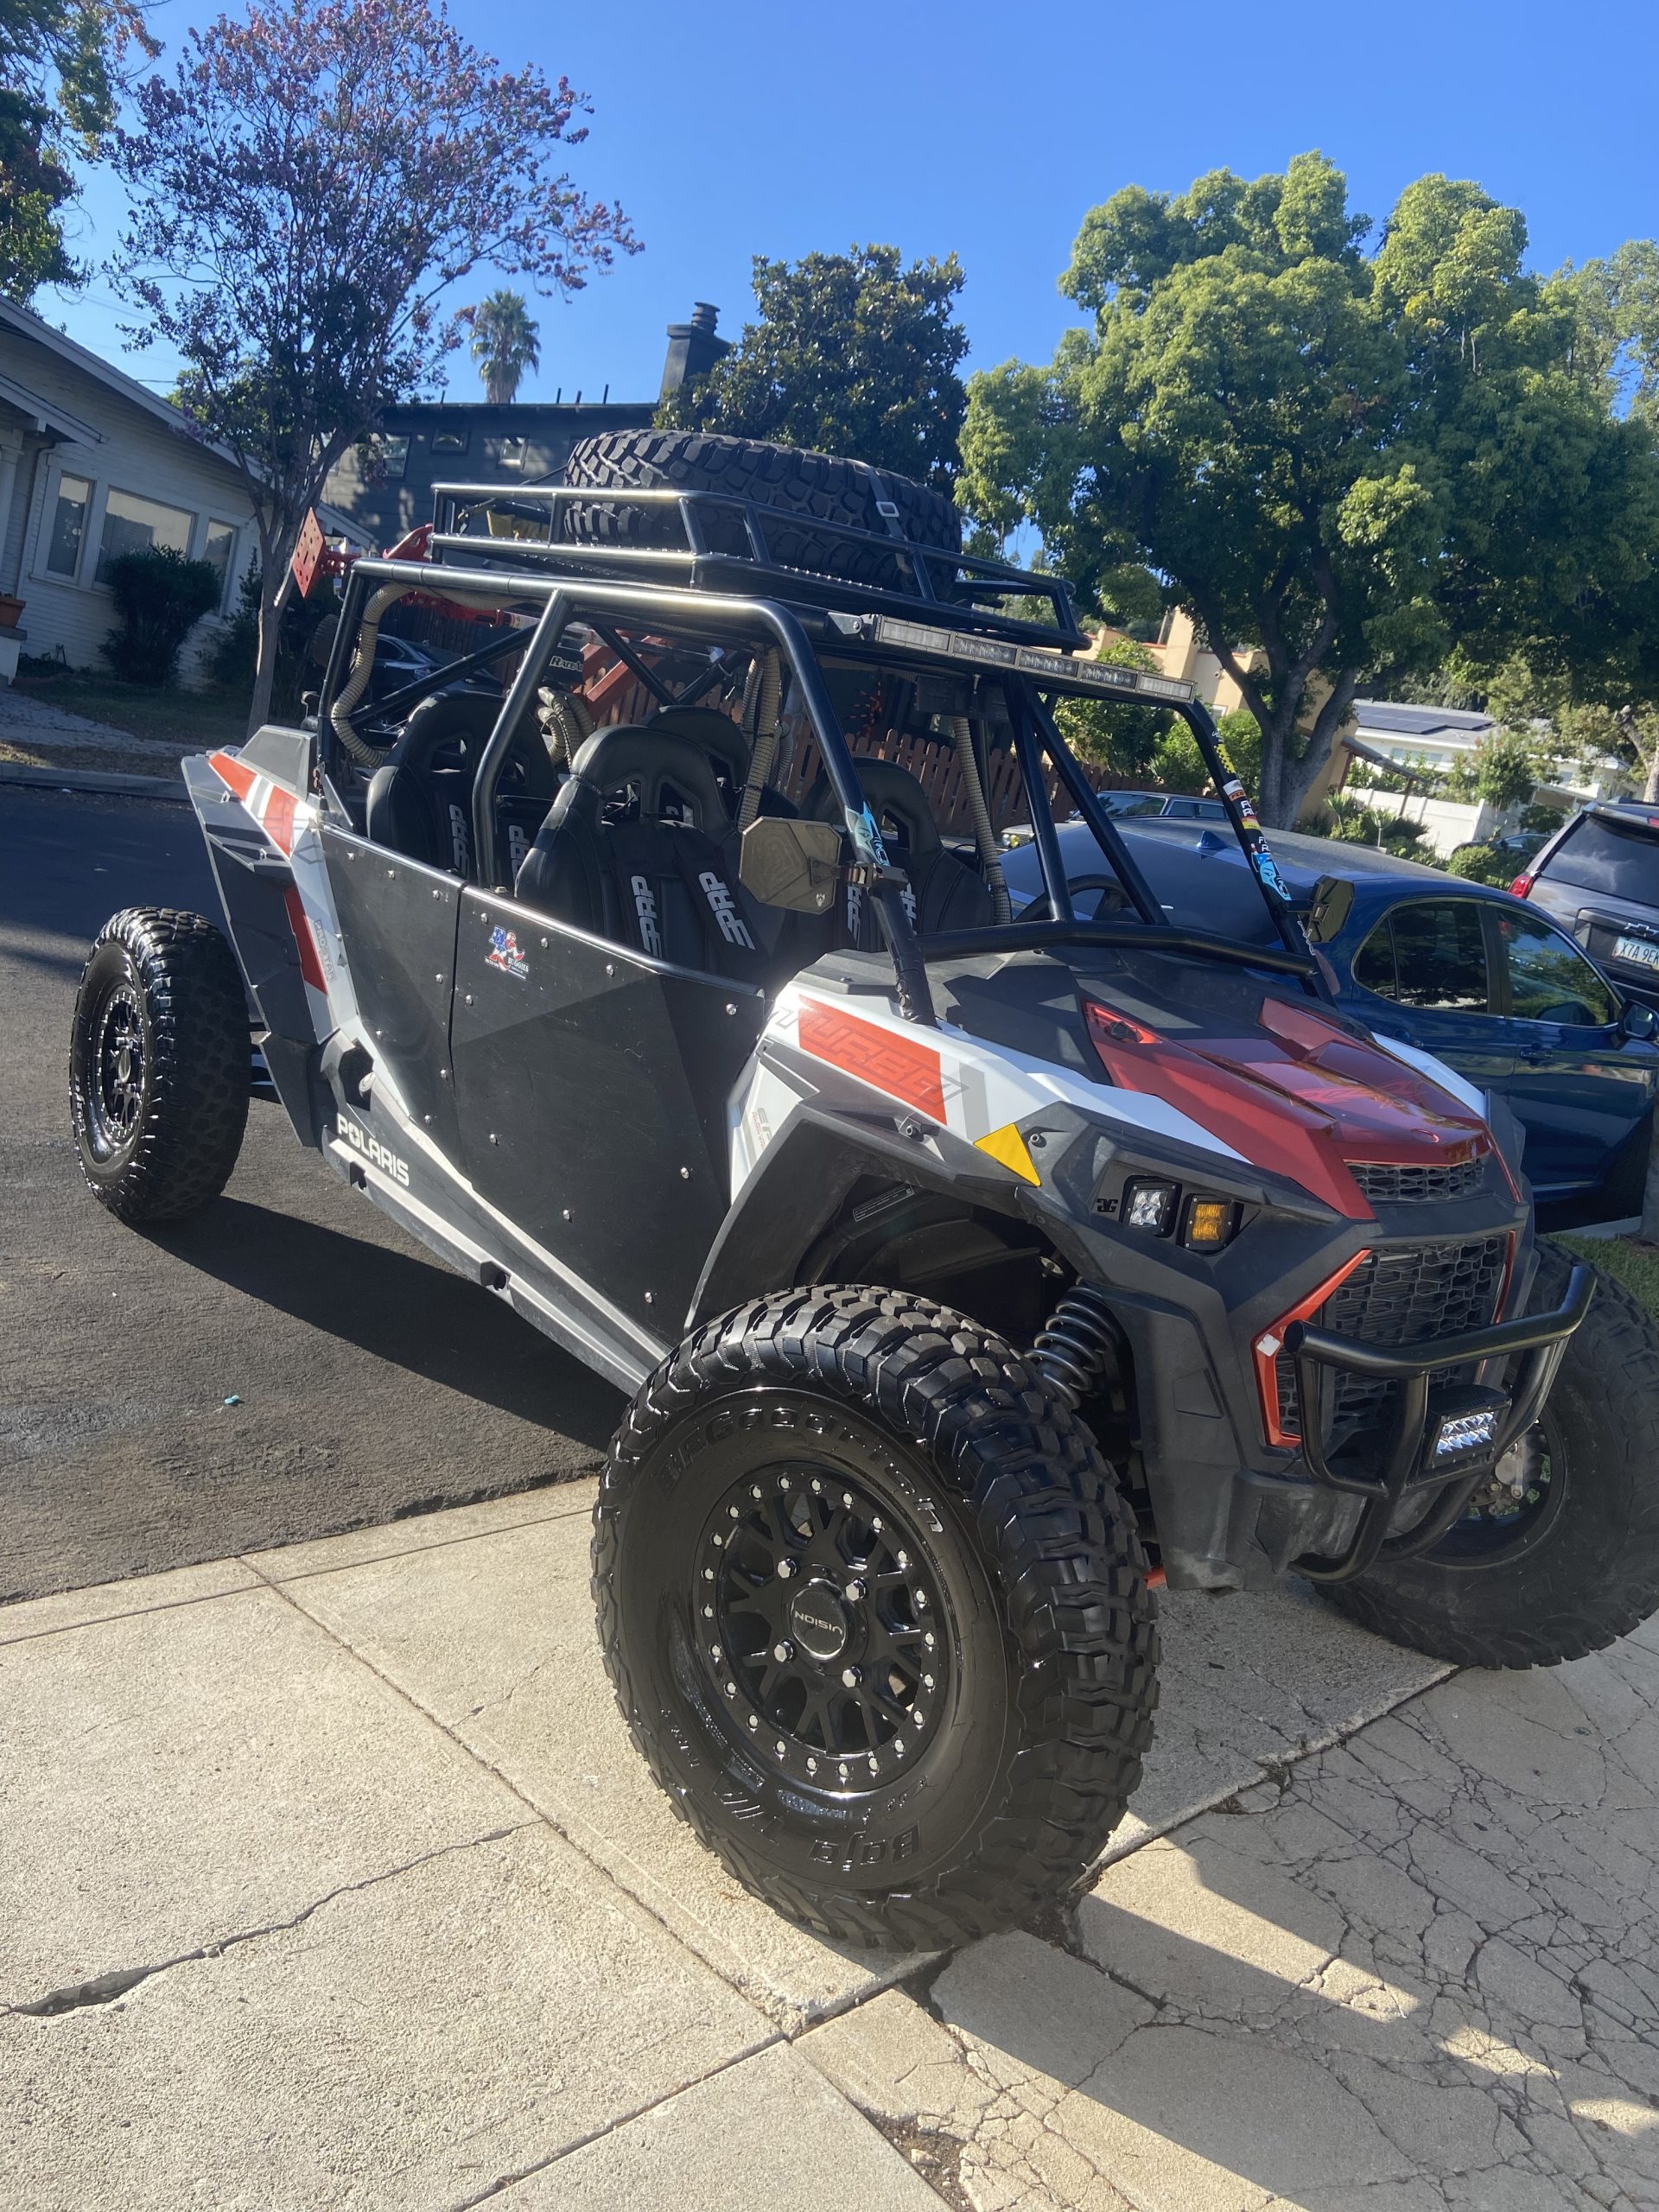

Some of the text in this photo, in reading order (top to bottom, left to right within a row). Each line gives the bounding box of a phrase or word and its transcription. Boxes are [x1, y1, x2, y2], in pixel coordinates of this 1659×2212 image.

[631, 875, 662, 959] PRP
[699, 872, 756, 950] PRP
[337, 1113, 410, 1187] POLARIS
[794, 1610, 843, 1636] VISION
